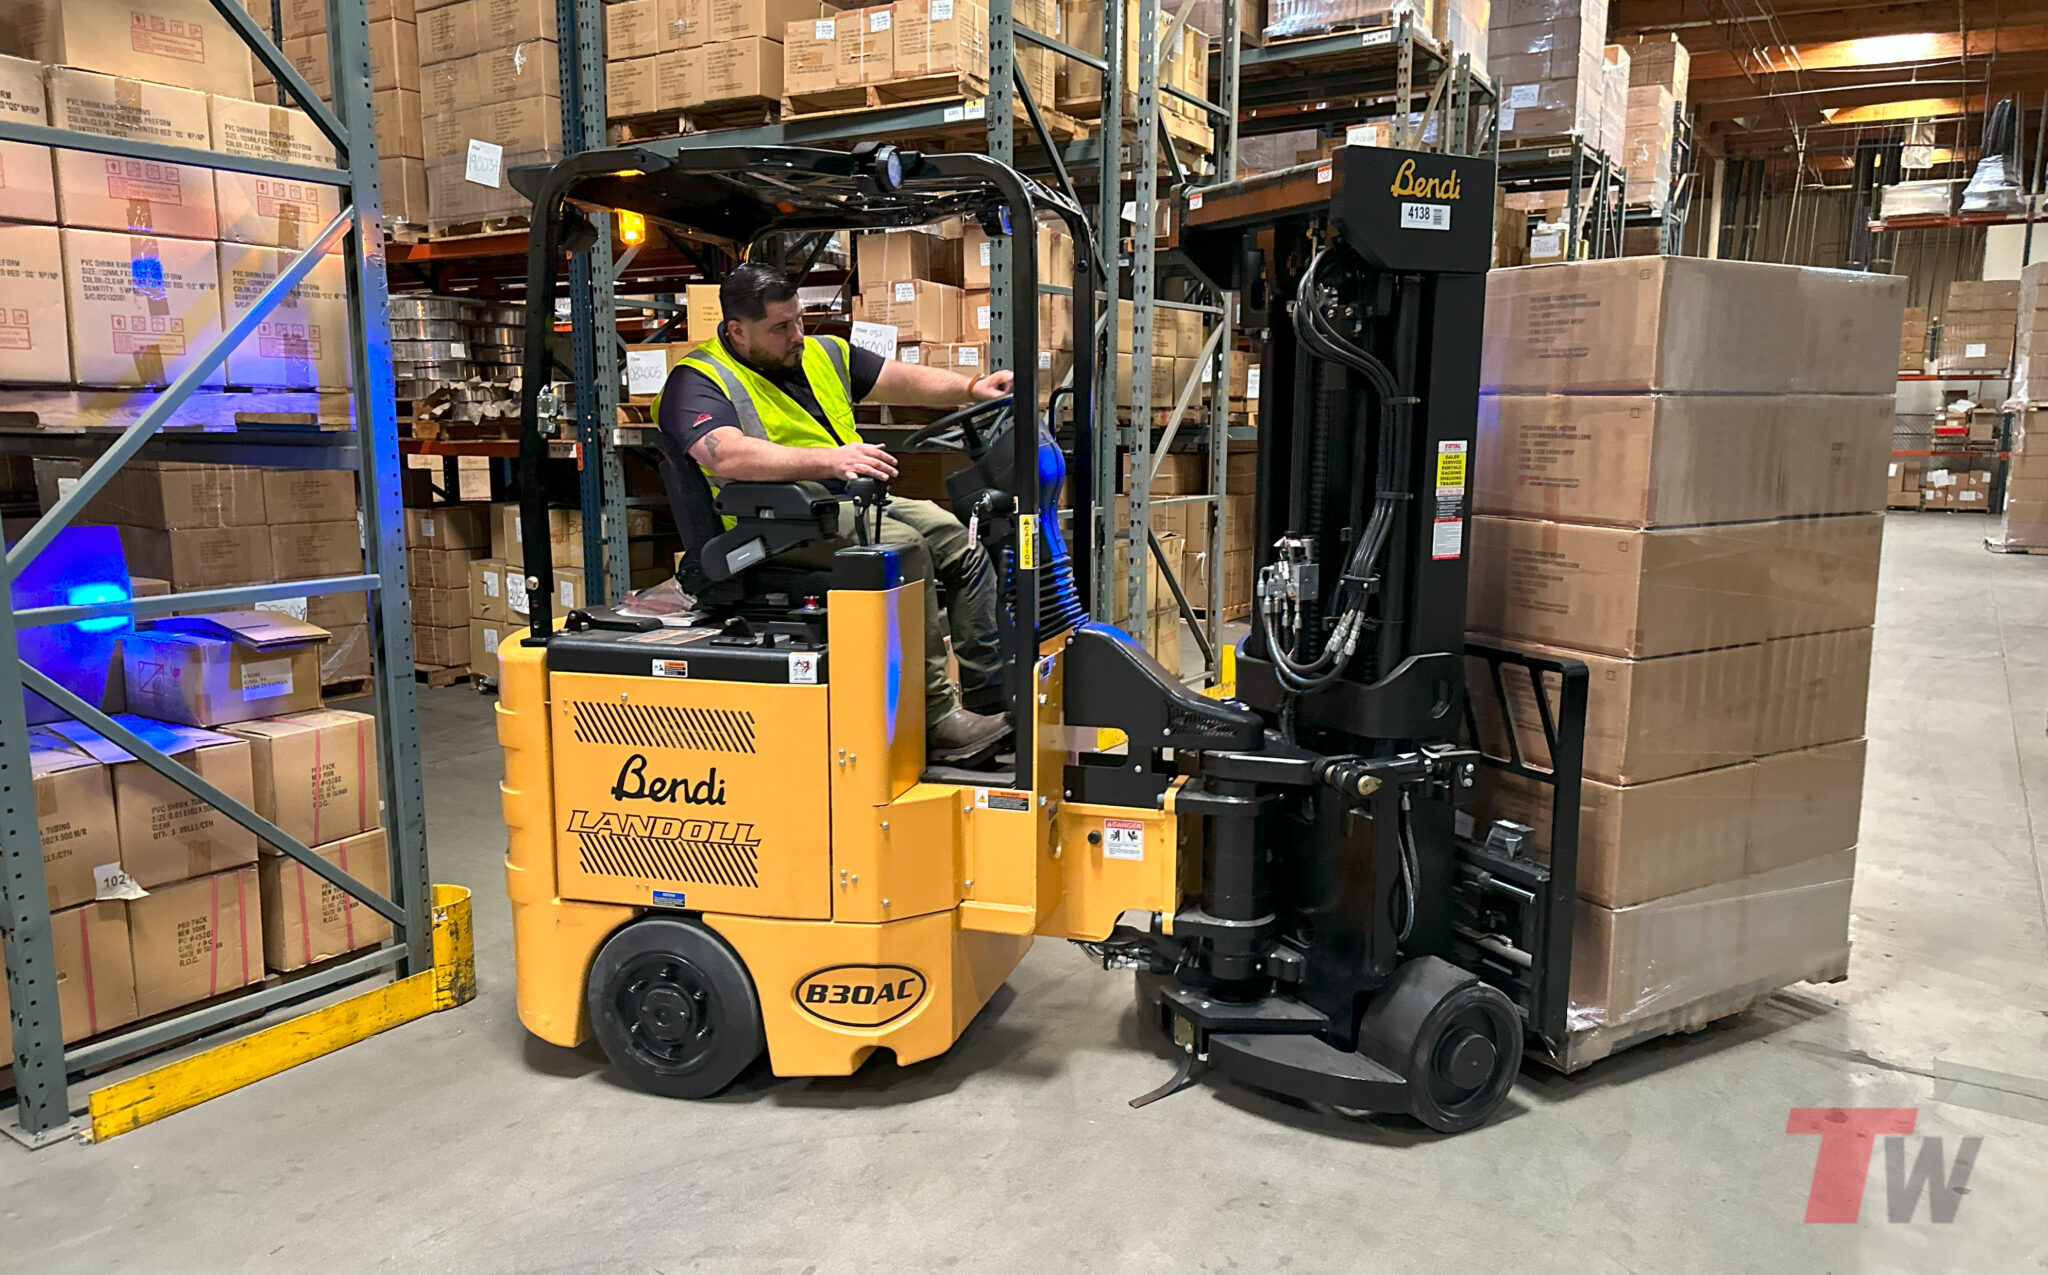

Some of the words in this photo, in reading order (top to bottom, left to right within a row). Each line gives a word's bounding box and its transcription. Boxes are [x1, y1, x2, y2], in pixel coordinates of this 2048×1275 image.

[1390, 158, 1461, 199] Bendi
[1408, 206, 1430, 220] 4138
[611, 754, 726, 805] Bendi
[151, 804, 166, 814] PVC
[46, 822, 71, 834] TUBING
[152, 821, 170, 831] CLEAR
[566, 810, 762, 847] LANDOLL
[1112, 820, 1142, 831] DANGER
[44, 848, 72, 863] LLS/CTN
[805, 977, 915, 1005] B30AC
